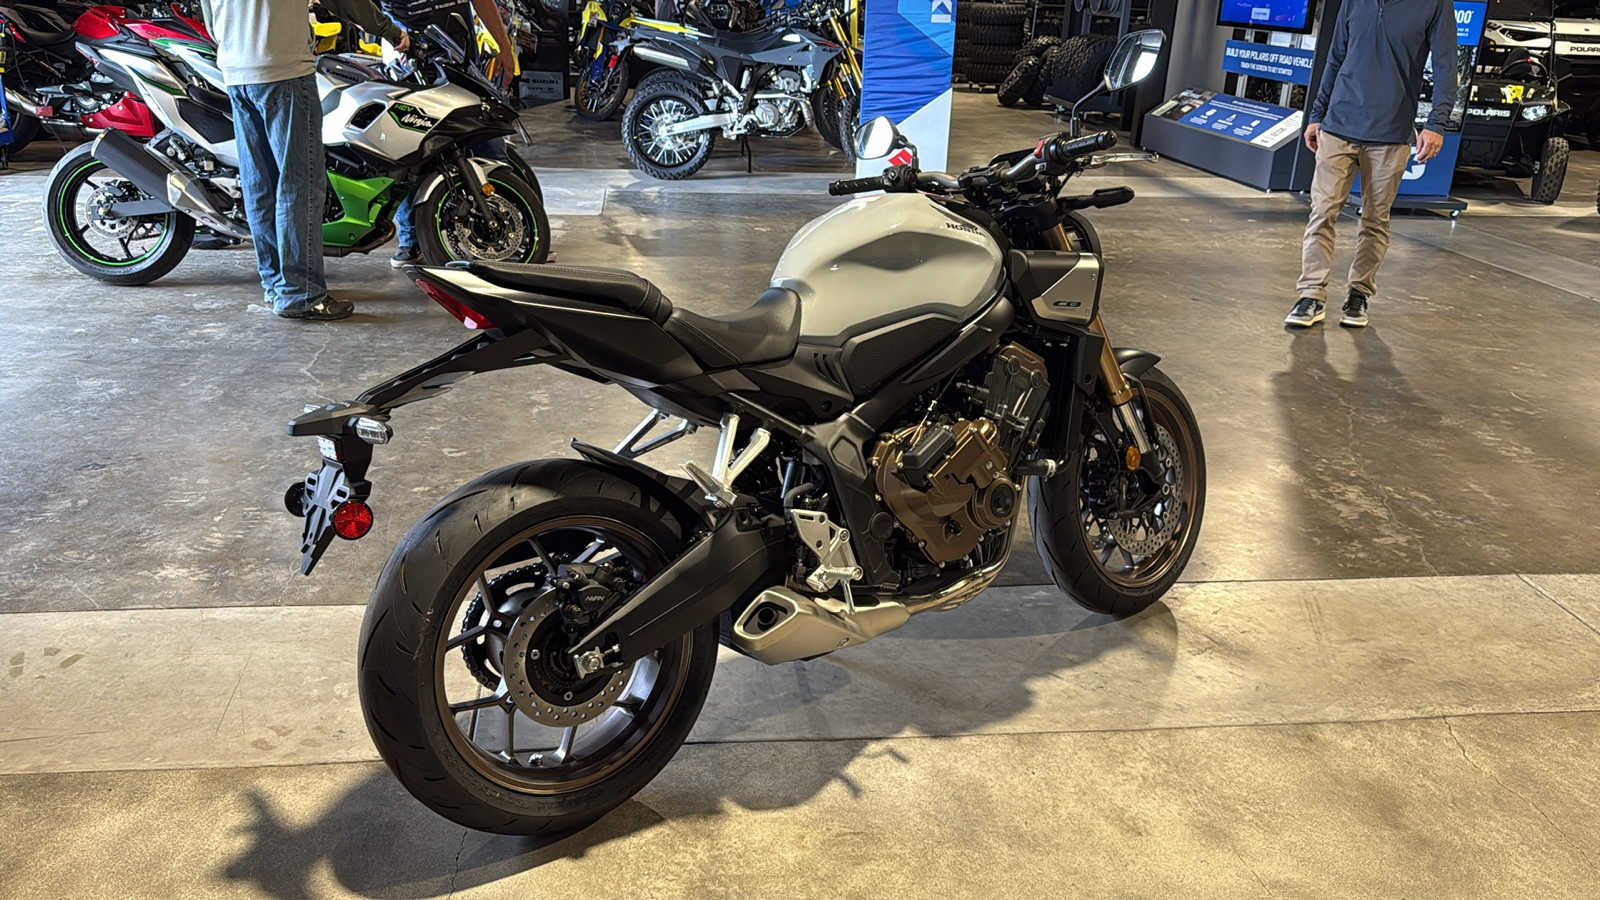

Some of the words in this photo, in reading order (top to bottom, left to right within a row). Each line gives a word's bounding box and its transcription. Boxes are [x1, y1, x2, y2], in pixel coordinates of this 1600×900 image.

[1226, 47, 1239, 57] BUILD
[1239, 50, 1251, 59] YOUR
[1251, 51, 1269, 62] POLARIS
[1269, 53, 1280, 64] OFF
[1279, 55, 1292, 66] ROAD
[1293, 56, 1314, 69] VEHICLE
[326, 67, 360, 82] Kawasaki
[394, 103, 415, 112] HEV
[1466, 108, 1511, 117] POLARIS
[401, 113, 431, 127] Ninja
[946, 222, 987, 239] HONDA
